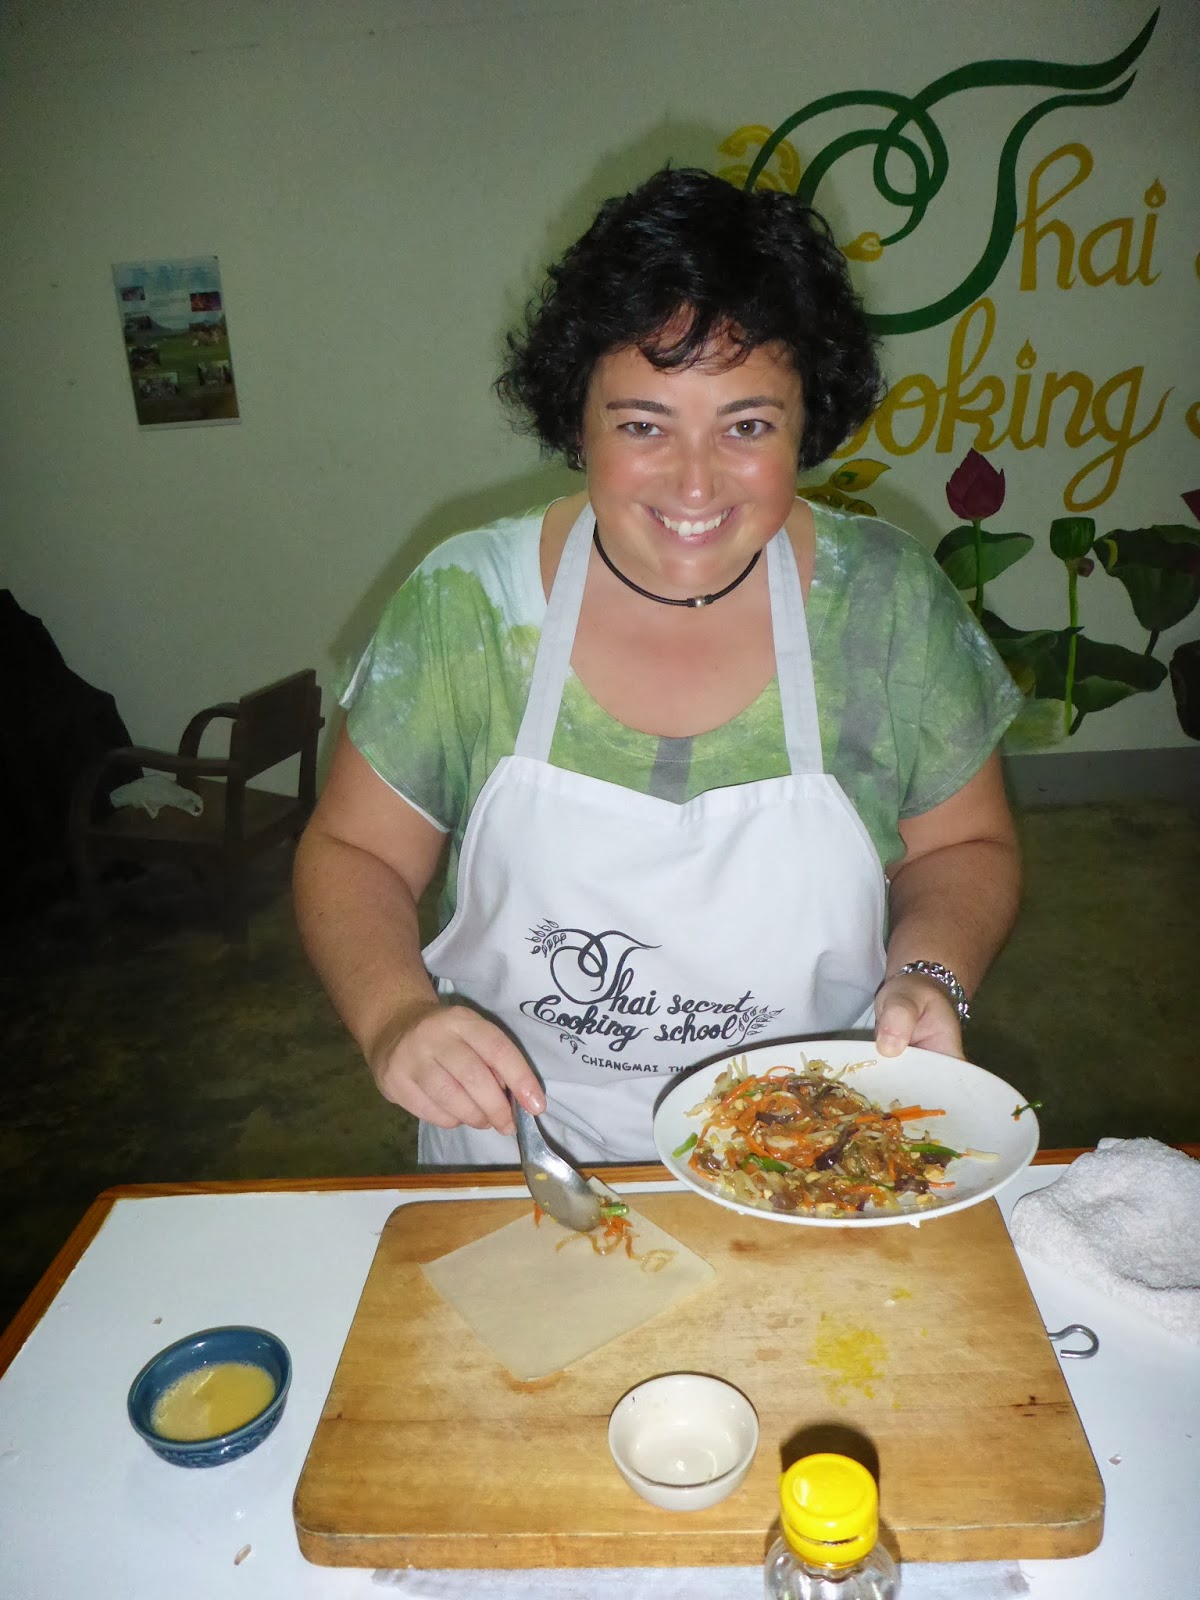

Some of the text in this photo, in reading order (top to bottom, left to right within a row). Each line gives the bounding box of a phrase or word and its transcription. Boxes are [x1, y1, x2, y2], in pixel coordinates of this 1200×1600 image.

[745, 6, 1166, 335] Thai
[832, 298, 1175, 512] oking
[550, 929, 755, 1016] Thai secret
[520, 995, 738, 1052] Cooking school
[581, 1054, 659, 1073] CHIANGMAI
